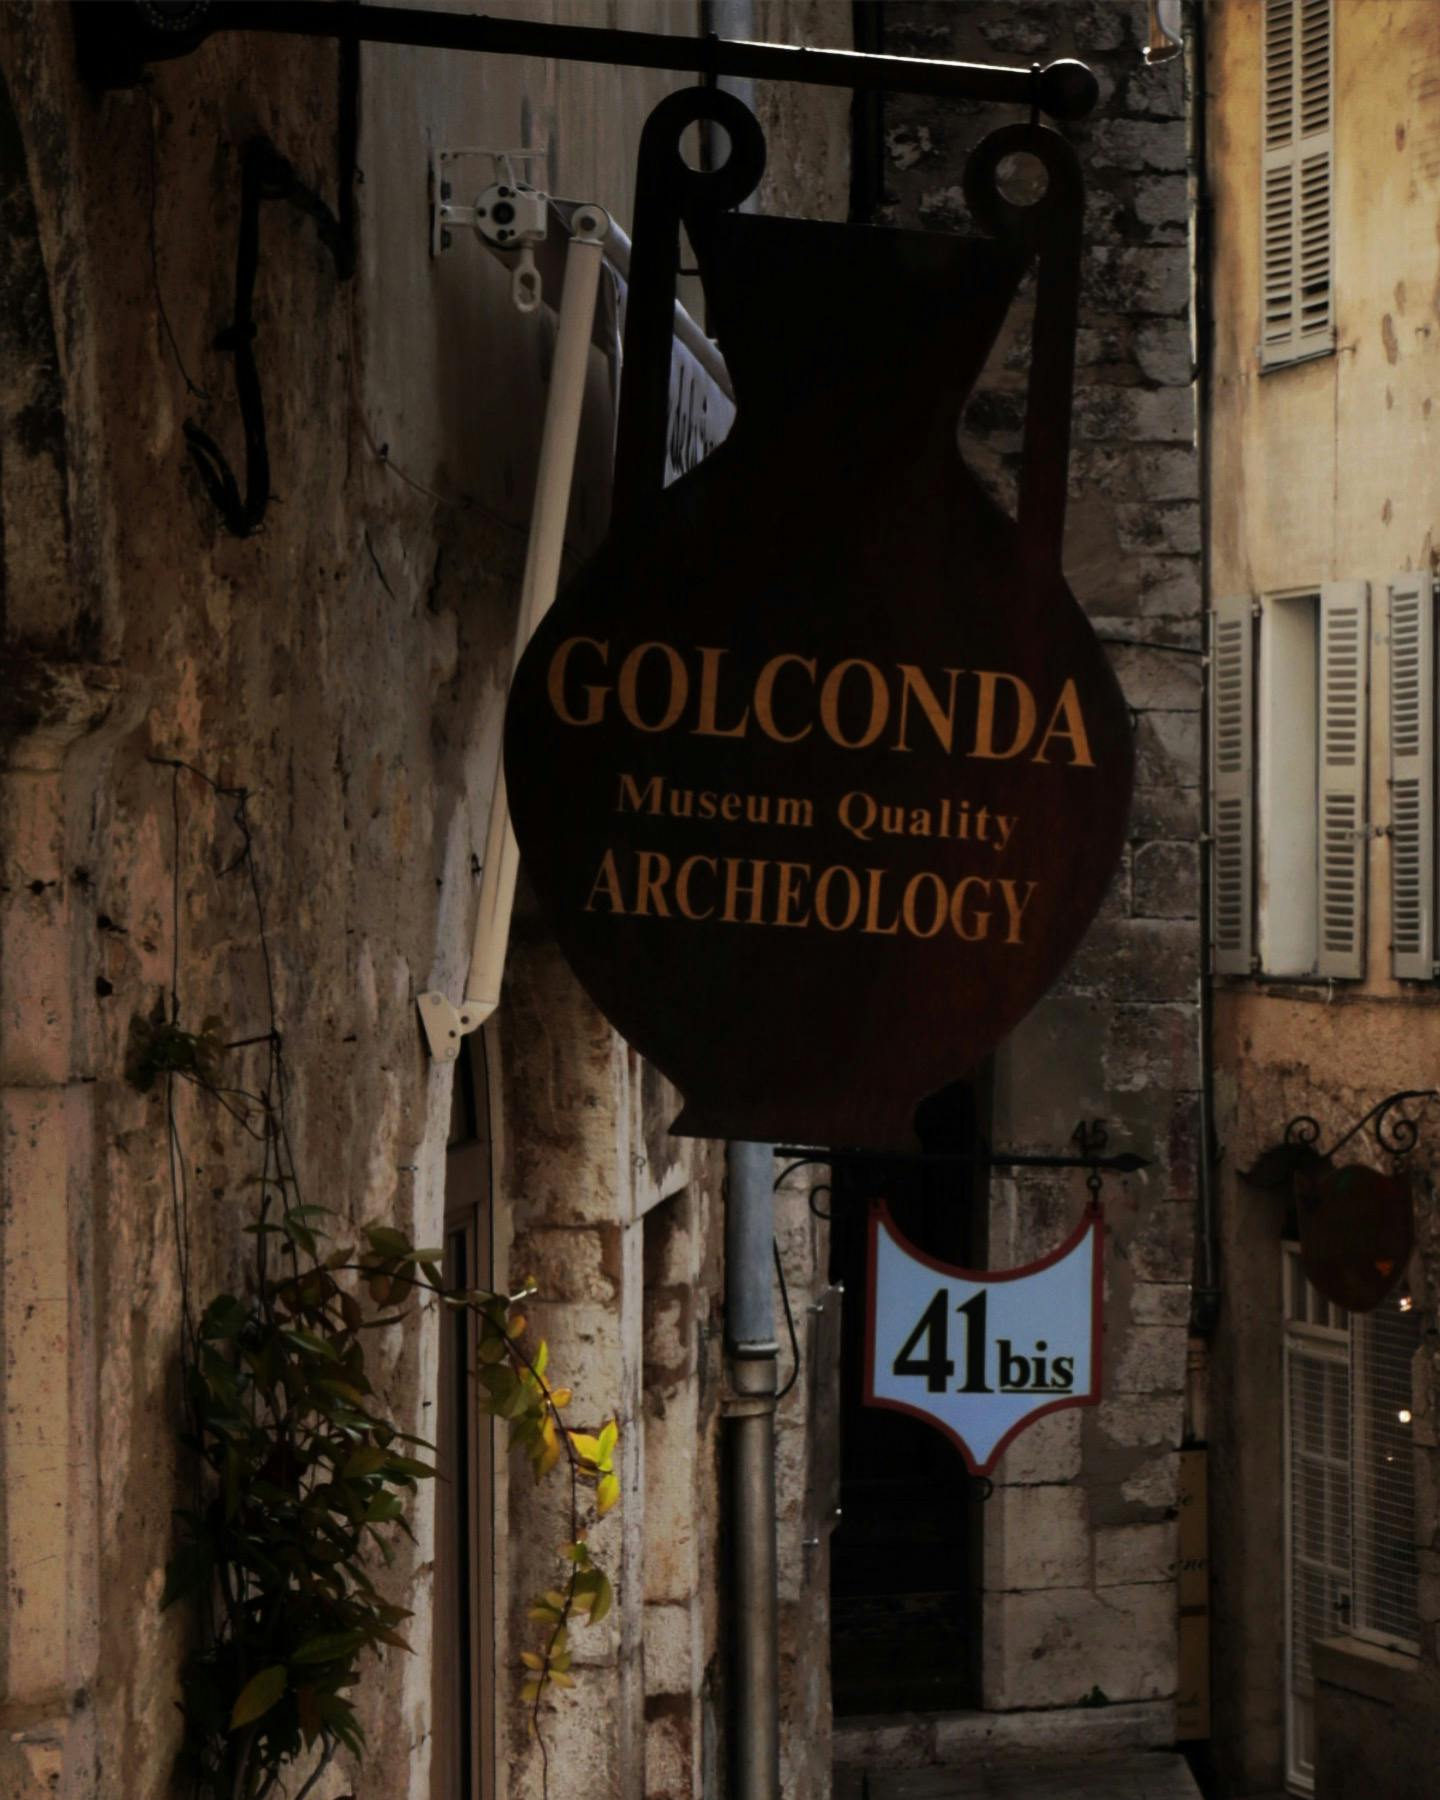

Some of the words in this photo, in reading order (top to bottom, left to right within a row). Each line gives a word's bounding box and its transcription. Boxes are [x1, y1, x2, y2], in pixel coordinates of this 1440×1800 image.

[546, 635, 1097, 768] GOLCONDA
[615, 773, 814, 827] Museum
[837, 790, 1019, 851] Quality
[583, 847, 1038, 945] ARCHEOLOGY
